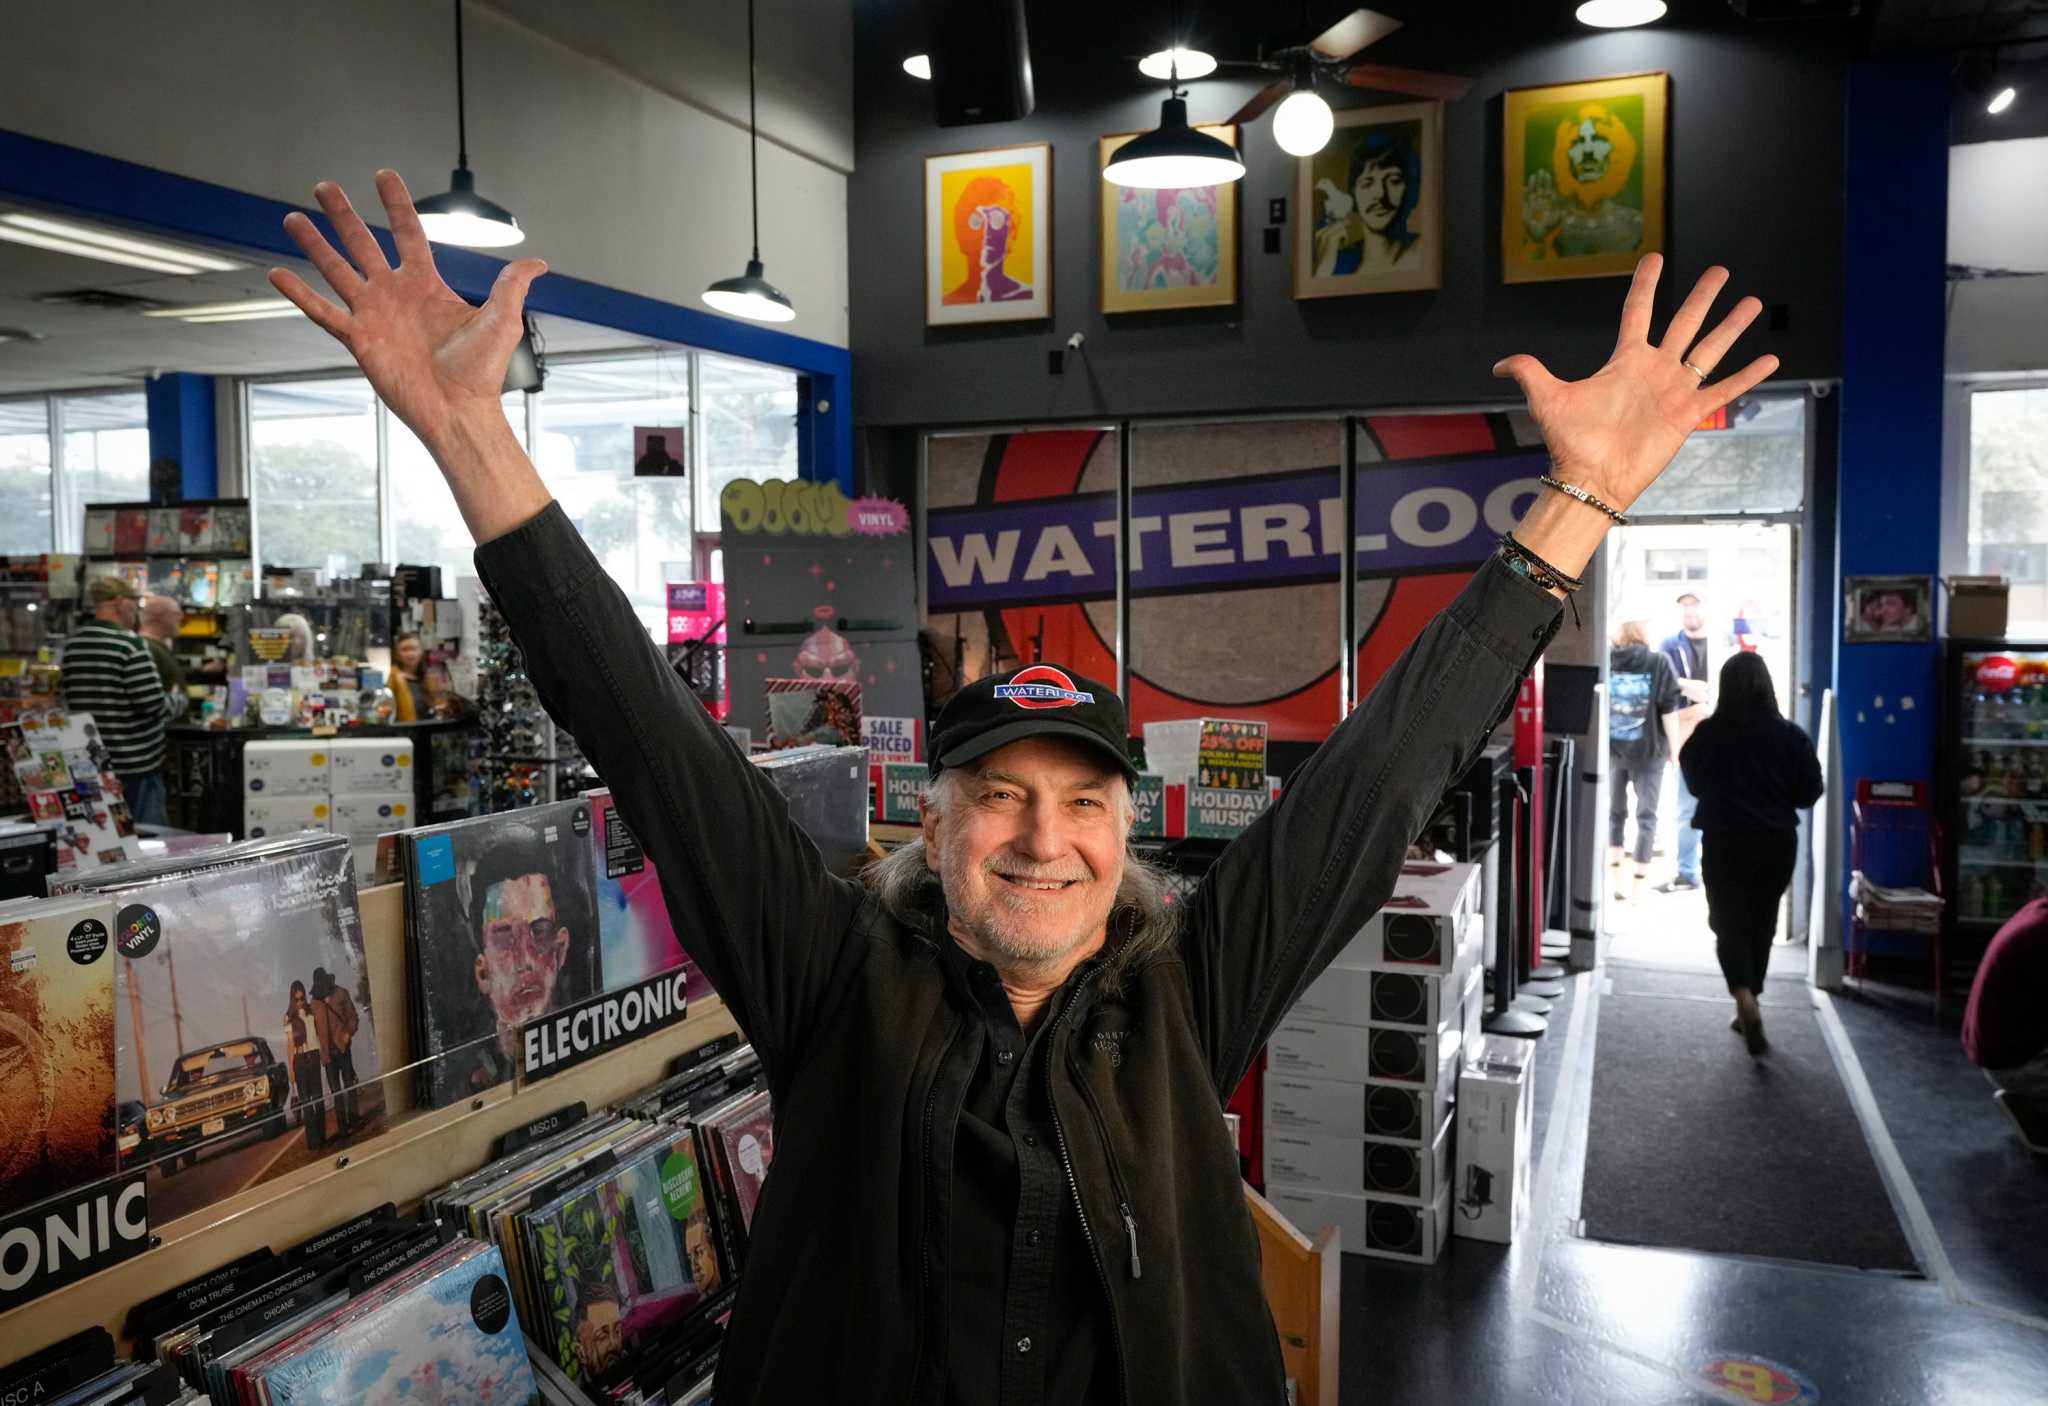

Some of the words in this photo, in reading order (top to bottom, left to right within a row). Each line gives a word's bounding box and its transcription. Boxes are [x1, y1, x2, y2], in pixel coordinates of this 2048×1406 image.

[858, 513, 896, 527] VINYL
[870, 720, 903, 736] SALE
[863, 736, 912, 753] PRICED
[1235, 736, 1265, 752] OFF
[888, 779, 923, 795] HOLI
[1191, 790, 1266, 811] HOLIDAY
[1201, 809, 1257, 826] MUSIC
[126, 925, 155, 951] VINYL
[525, 971, 687, 1073] ELECTRONIC
[529, 1120, 550, 1137] MISC
[551, 1116, 559, 1129] D
[352, 1238, 373, 1254] CLARK
[406, 1235, 439, 1259] BROTHERS
[189, 1295, 208, 1311] COM
[207, 1283, 235, 1299] TRUISE
[219, 1311, 235, 1324] THE
[263, 1297, 296, 1321] CHICANE
